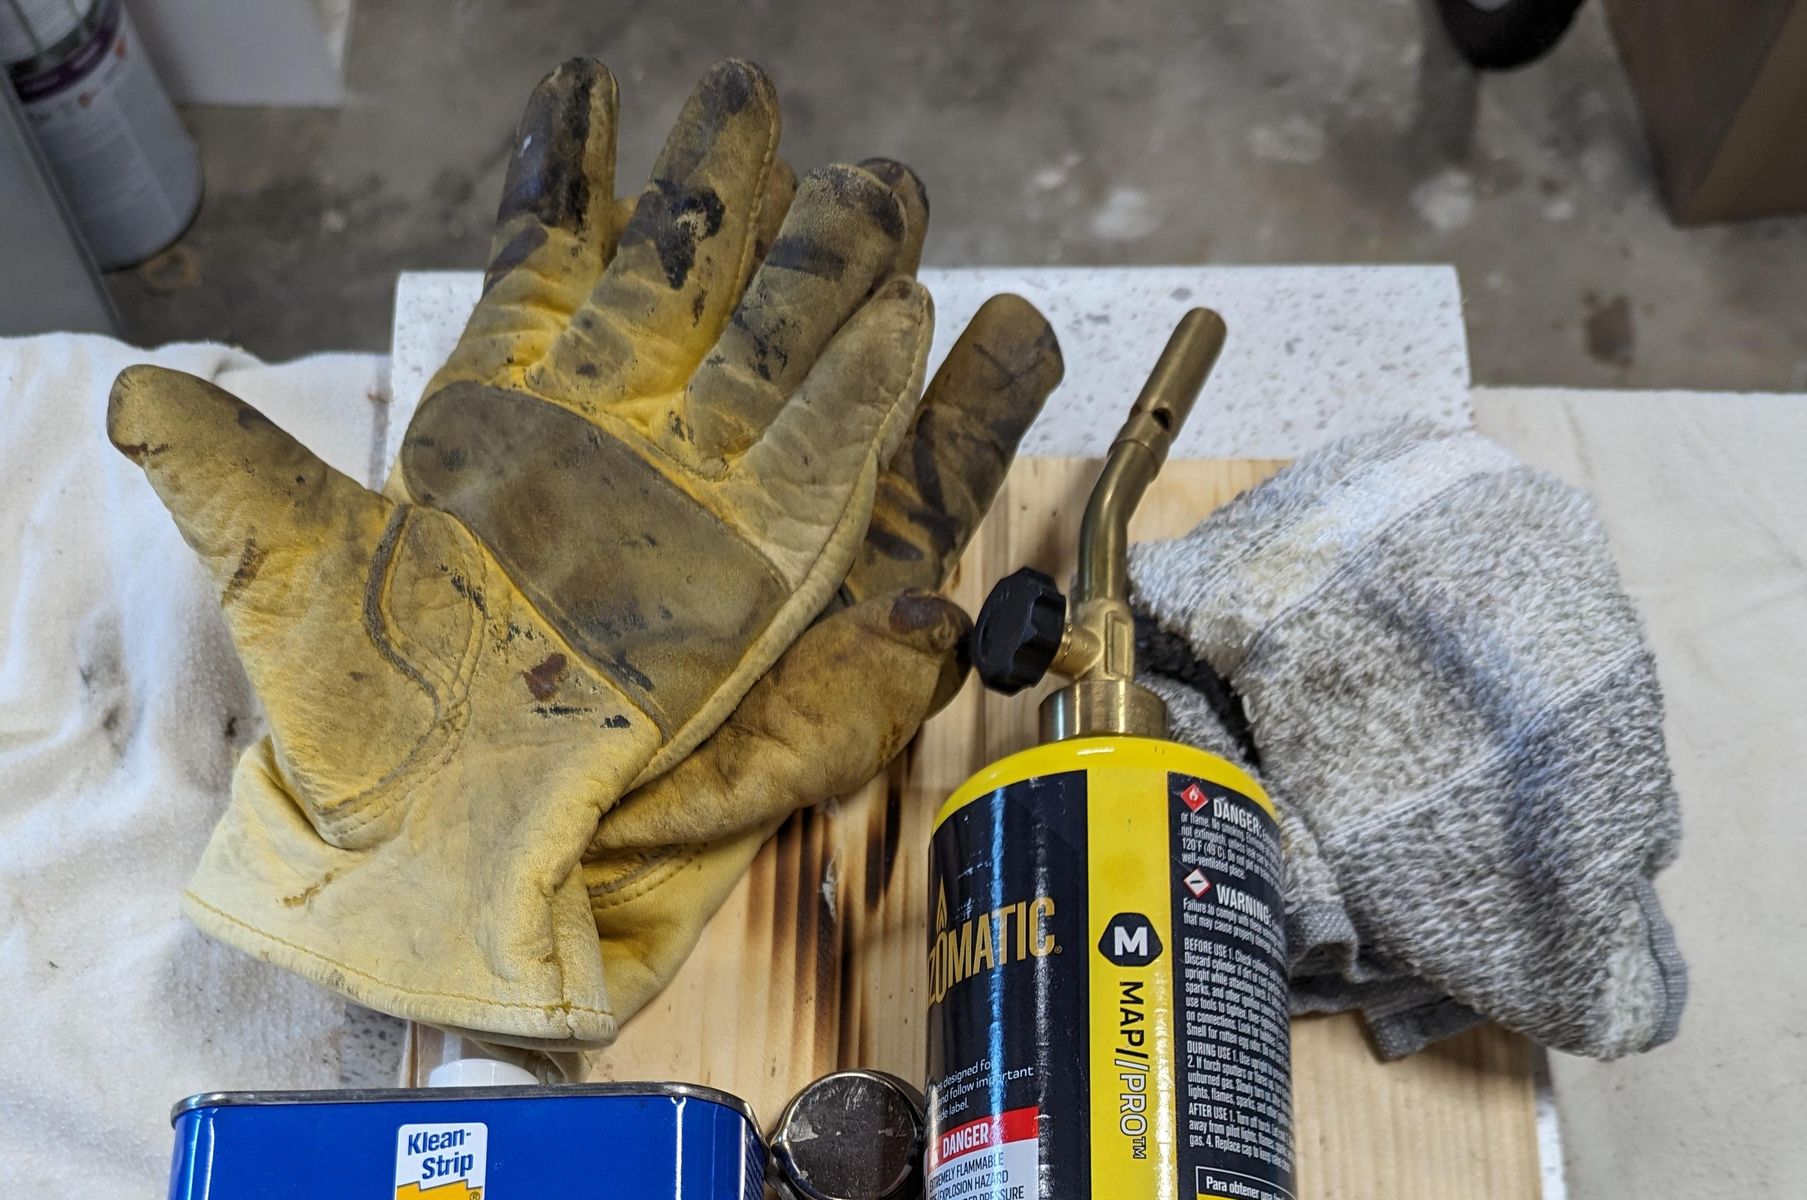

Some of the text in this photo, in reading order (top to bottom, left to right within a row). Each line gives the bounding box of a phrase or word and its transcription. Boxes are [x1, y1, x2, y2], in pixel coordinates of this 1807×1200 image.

[1190, 811, 1210, 828] flame.
[1213, 798, 1262, 838] DANGER:
[1181, 826, 1193, 837] not
[1182, 852, 1228, 873] well-ventilated
[1183, 897, 1206, 914] Failure
[1216, 883, 1272, 928] WARNING:
[1183, 912, 1233, 935] that may cause
[1114, 925, 1148, 957] M
[1184, 937, 1212, 955] BEFORE
[1214, 943, 1228, 960] USE
[1184, 951, 1211, 968] Discard
[1185, 967, 1209, 982] upright
[1185, 981, 1210, 996] sparks,
[1212, 986, 1224, 999] and
[1185, 996, 1199, 1008] use
[1201, 997, 1217, 1011] tools
[1186, 1010, 1195, 1022] on
[1186, 1022, 1207, 1038] Smell
[1208, 1025, 1217, 1039] for
[1187, 1040, 1216, 1058] DURING
[1217, 1045, 1231, 1061] USE
[943, 1060, 979, 1089] designed
[980, 1058, 996, 1073] fo
[1187, 1055, 1195, 1068] 2.
[1203, 1058, 1221, 1073] torch
[950, 1082, 975, 1100] follow
[976, 1066, 1034, 1089] imprtant
[1187, 1071, 1220, 1087] unburned
[1221, 1076, 1235, 1090] gas.
[1188, 1083, 1210, 1100] lights,
[948, 1096, 970, 1116] label.
[1188, 1102, 1213, 1118] AFTER
[1213, 1105, 1227, 1121] USE
[1189, 1119, 1208, 1134] away
[1208, 1120, 1225, 1135] from
[407, 1128, 472, 1156] Klean-
[1189, 1134, 1205, 1148] gas.
[1205, 1134, 1214, 1148] 4.
[1214, 1135, 1241, 1153] Replace
[422, 1151, 474, 1180] Strip
[1206, 1176, 1227, 1193] Para
[1229, 1180, 1260, 1200] obtener
